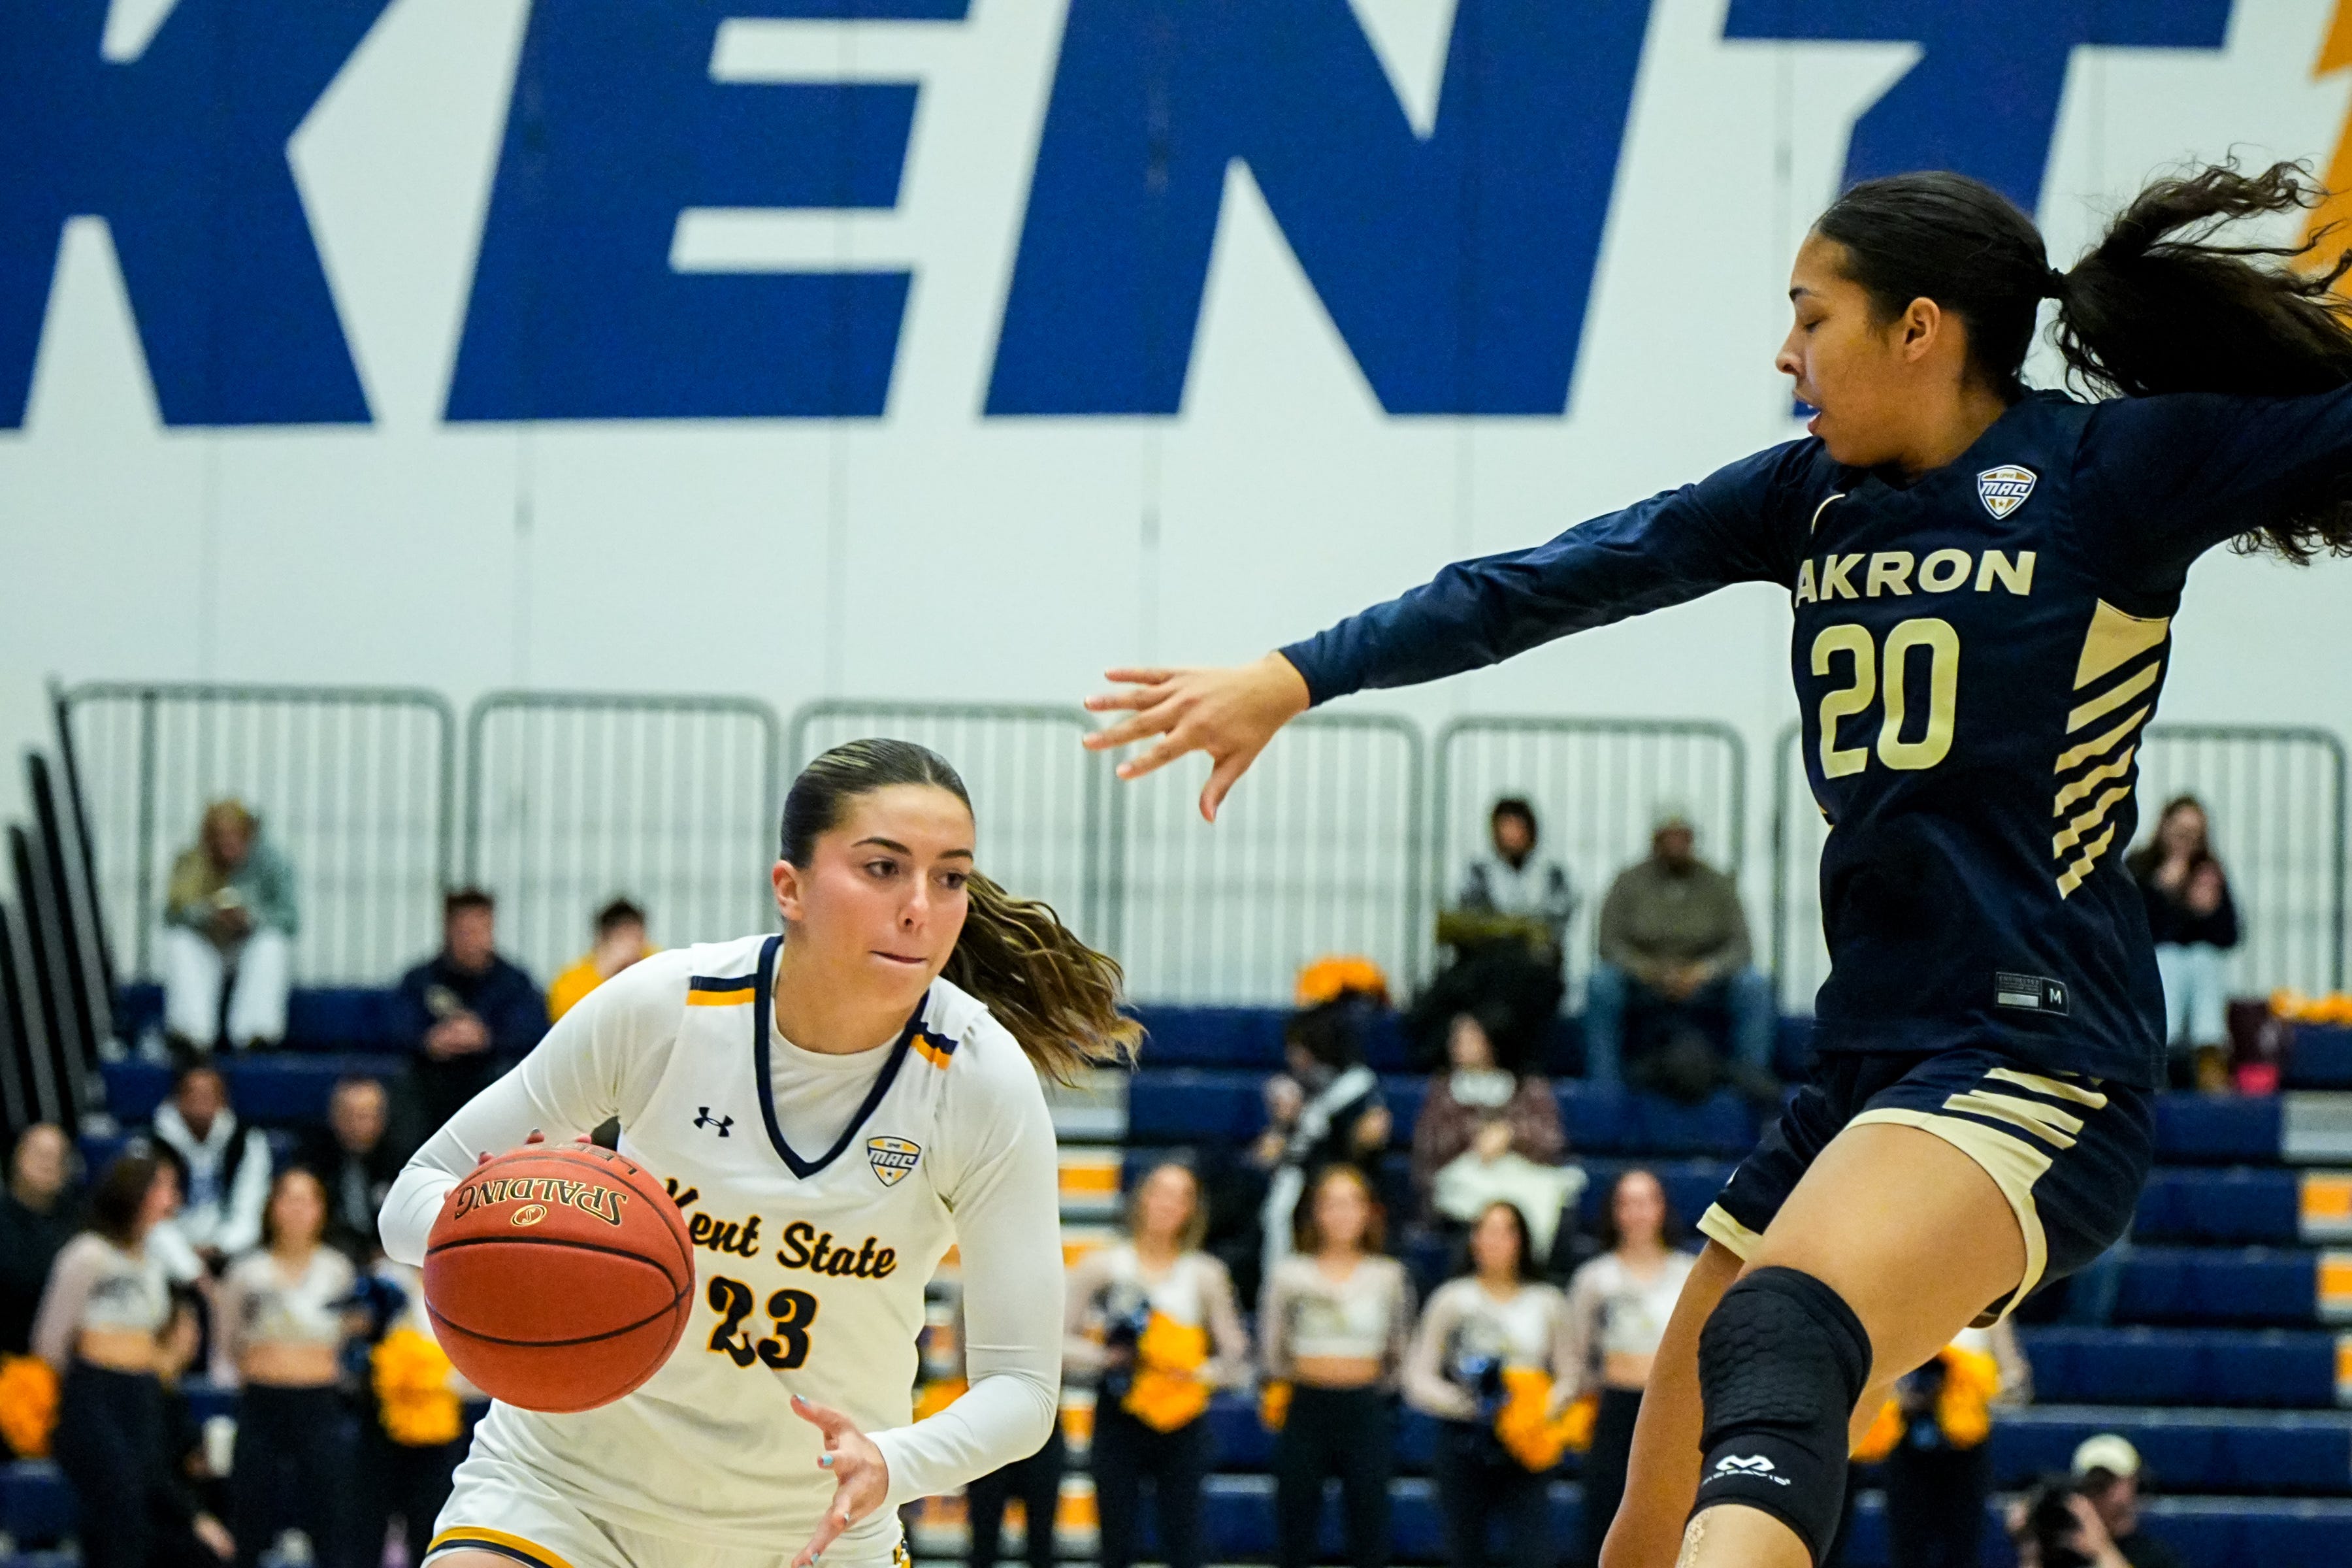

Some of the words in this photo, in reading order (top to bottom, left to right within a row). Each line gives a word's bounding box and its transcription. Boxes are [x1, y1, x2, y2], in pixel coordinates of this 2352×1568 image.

[0, 0, 2229, 424] KENT
[1981, 482, 2029, 497] MAC
[1795, 548, 2036, 608] AKRON
[1811, 617, 1960, 779] 20
[2049, 988, 2062, 1005] M
[869, 1149, 917, 1168] MAC
[454, 1178, 628, 1226] SPALDING
[776, 1220, 898, 1279] State
[706, 1275, 820, 1370] 23
